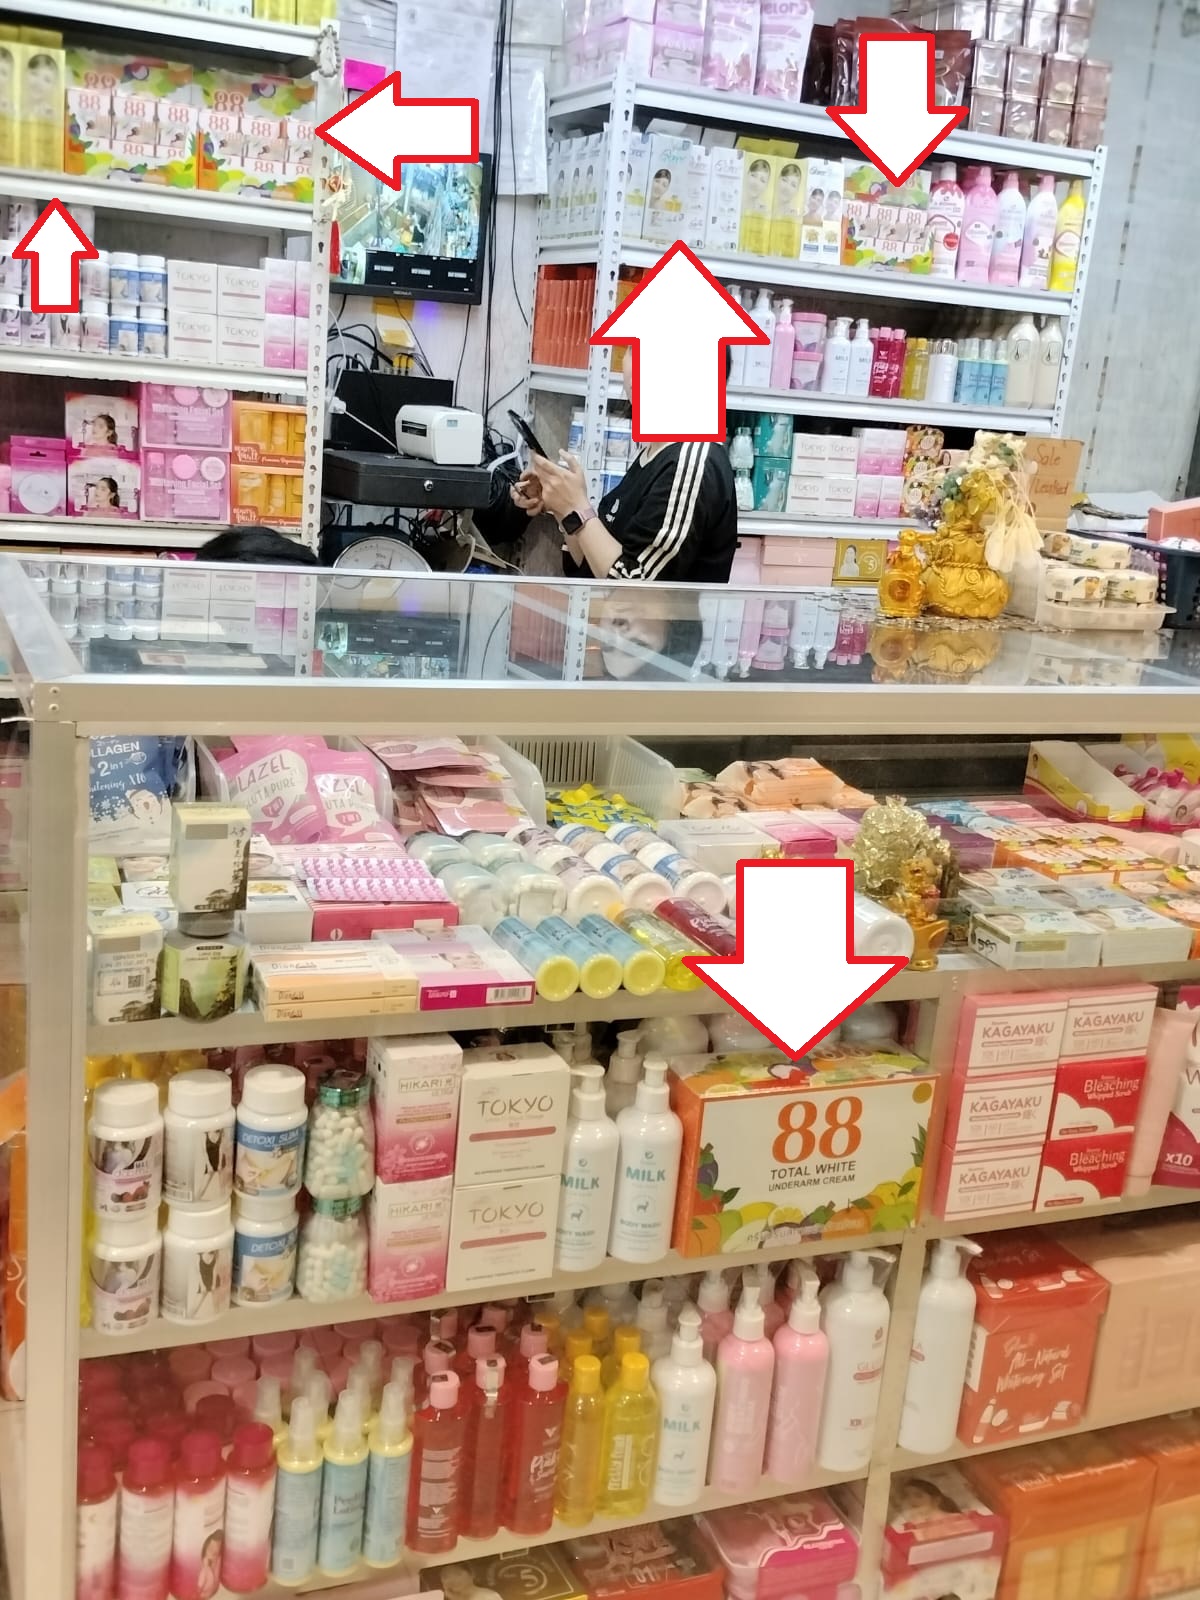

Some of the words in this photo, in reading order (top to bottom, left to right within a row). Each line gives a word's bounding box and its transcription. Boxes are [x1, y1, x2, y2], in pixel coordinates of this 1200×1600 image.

[79, 94, 100, 111] 88
[124, 100, 146, 117] 88
[214, 91, 245, 113] 88
[168, 107, 189, 123] 88
[209, 116, 229, 131] 88
[250, 121, 271, 137] 88
[297, 125, 316, 140] 88
[847, 203, 863, 217] 88
[877, 208, 892, 223] 88
[907, 211, 922, 225] 88
[176, 271, 211, 284] TOKYO
[225, 276, 259, 289] TOKYO
[176, 321, 211, 334] TOKYO
[225, 326, 258, 338] TOKYO
[1037, 444, 1061, 466] Sale
[90, 741, 140, 758] LLAGEN
[97, 761, 112, 777] 2
[237, 754, 290, 792] LAZEL
[325, 798, 346, 810] UTA
[1074, 1011, 1145, 1029] KAGAYAKU
[982, 1022, 1055, 1039] KAGAYAKU
[400, 1079, 443, 1091] HIKARI
[1084, 1078, 1140, 1094] Bleaching
[477, 1095, 553, 1117] TOKYO
[970, 1096, 1043, 1113] KAGAYAKU
[772, 1096, 863, 1164] 88
[1069, 1150, 1126, 1167] Bleaching
[1164, 1151, 1194, 1167] x10
[626, 1166, 666, 1182] MILK
[770, 1166, 811, 1181] TOTAL
[815, 1161, 857, 1175] WHITE
[959, 1166, 1031, 1184] KAGAYAKU
[560, 1173, 599, 1190] MILK
[768, 1178, 820, 1192] UNDERARM
[822, 1174, 856, 1185] CREAM
[391, 1202, 434, 1215] HIKARI
[468, 1201, 544, 1225] TOKYO
[663, 1417, 701, 1433] MILK
